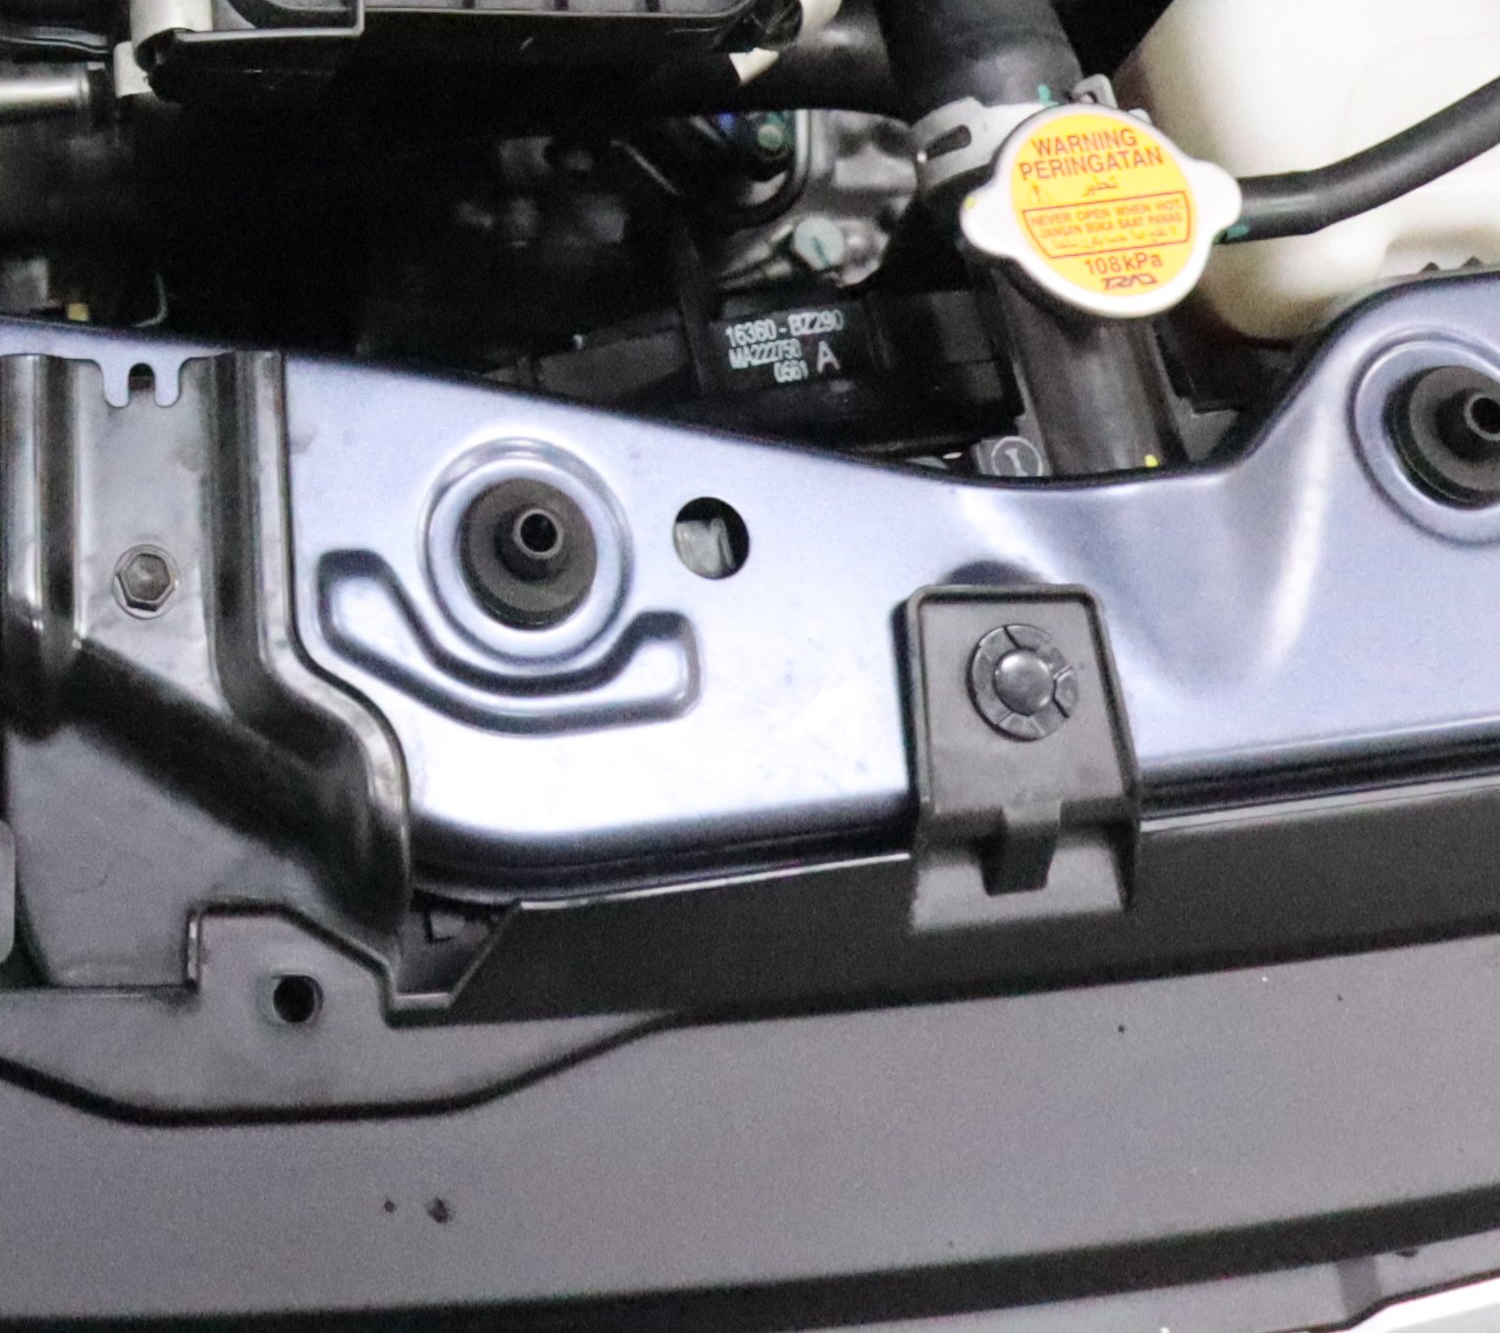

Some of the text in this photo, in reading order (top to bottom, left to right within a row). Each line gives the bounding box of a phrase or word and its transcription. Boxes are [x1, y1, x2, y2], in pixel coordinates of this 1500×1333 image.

[1031, 128, 1138, 157] WARNING
[1018, 146, 1164, 181] PERINGATAN
[1084, 252, 1163, 275] 108kPa
[816, 340, 841, 374] A
